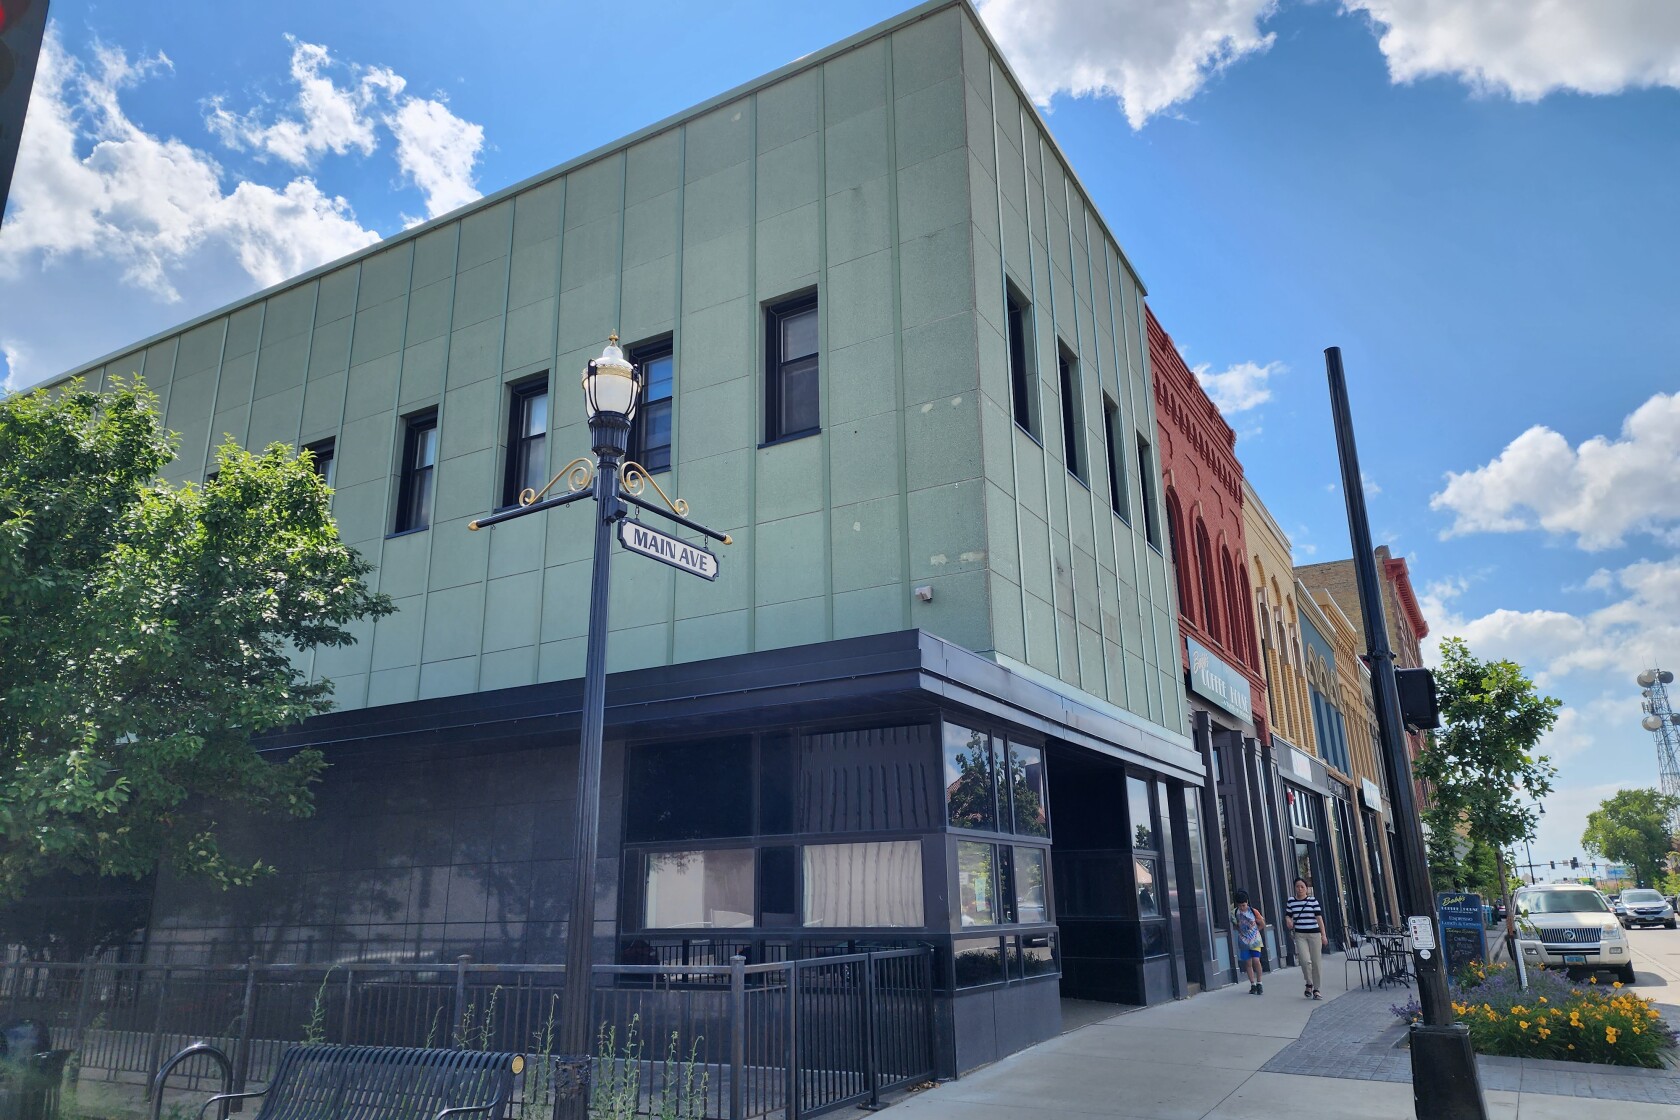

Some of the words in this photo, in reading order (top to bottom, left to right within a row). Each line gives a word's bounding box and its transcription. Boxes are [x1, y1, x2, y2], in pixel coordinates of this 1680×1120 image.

[634, 528, 676, 559] MAIN
[679, 547, 707, 572] AVE
[1201, 669, 1227, 699] COFFEE
[1230, 686, 1250, 714] HOUSE
